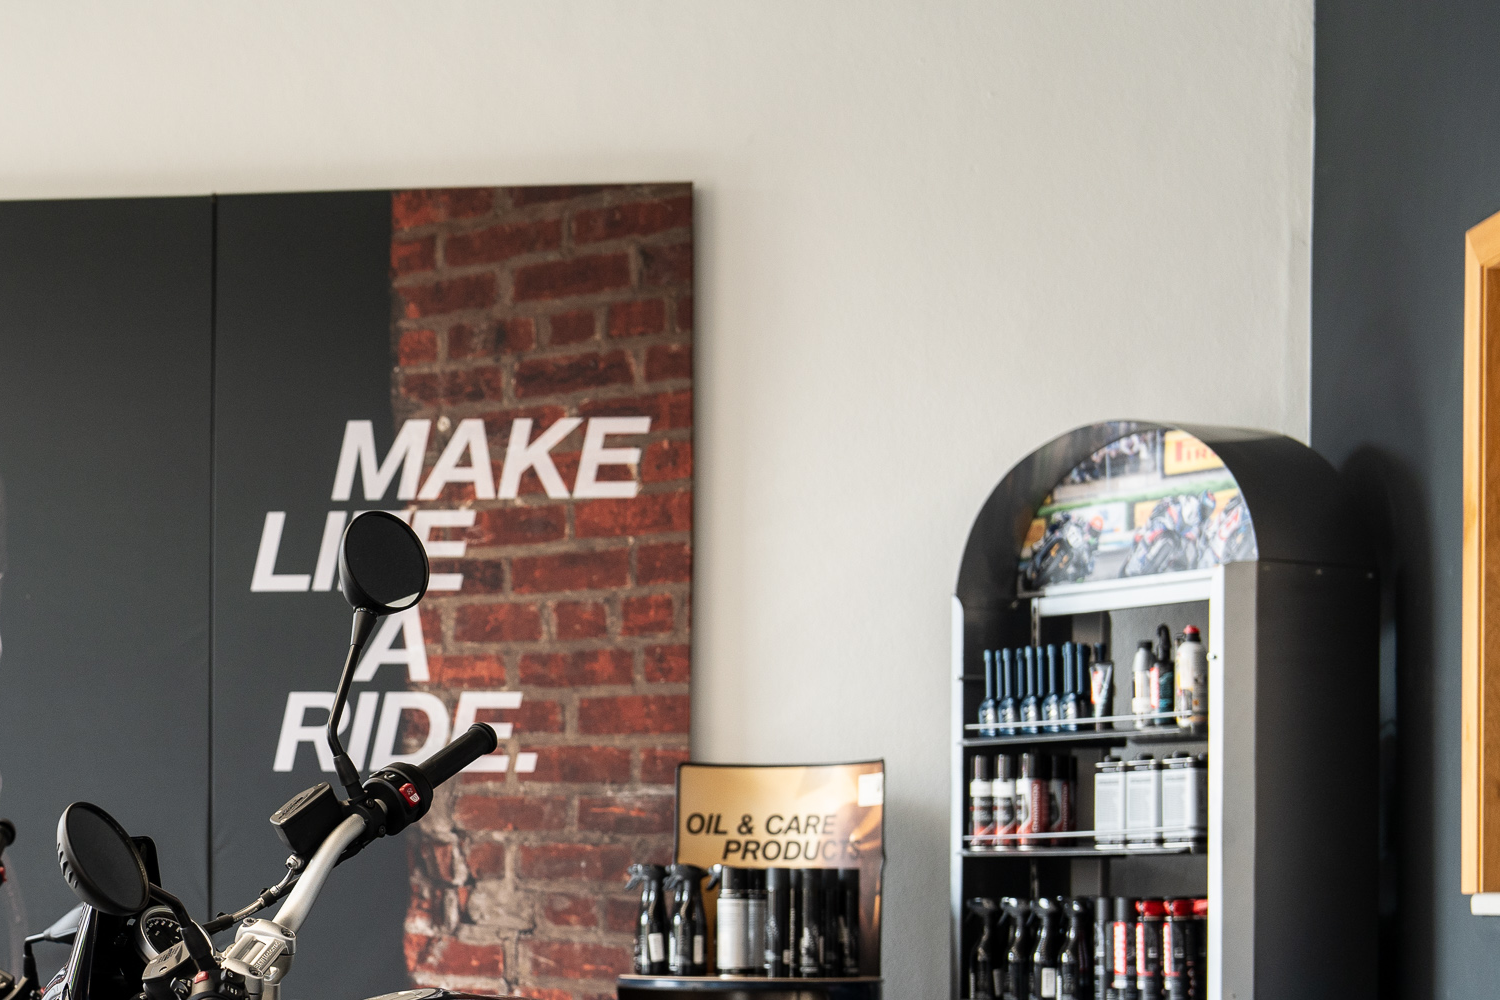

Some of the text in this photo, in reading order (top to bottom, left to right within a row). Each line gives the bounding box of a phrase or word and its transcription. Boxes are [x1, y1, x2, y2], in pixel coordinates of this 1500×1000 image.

[331, 416, 651, 501] MAKE
[250, 509, 477, 593] LIE
[353, 605, 430, 682] A
[686, 813, 838, 835] OIL & CARE
[722, 839, 861, 861] PRODUCTS
